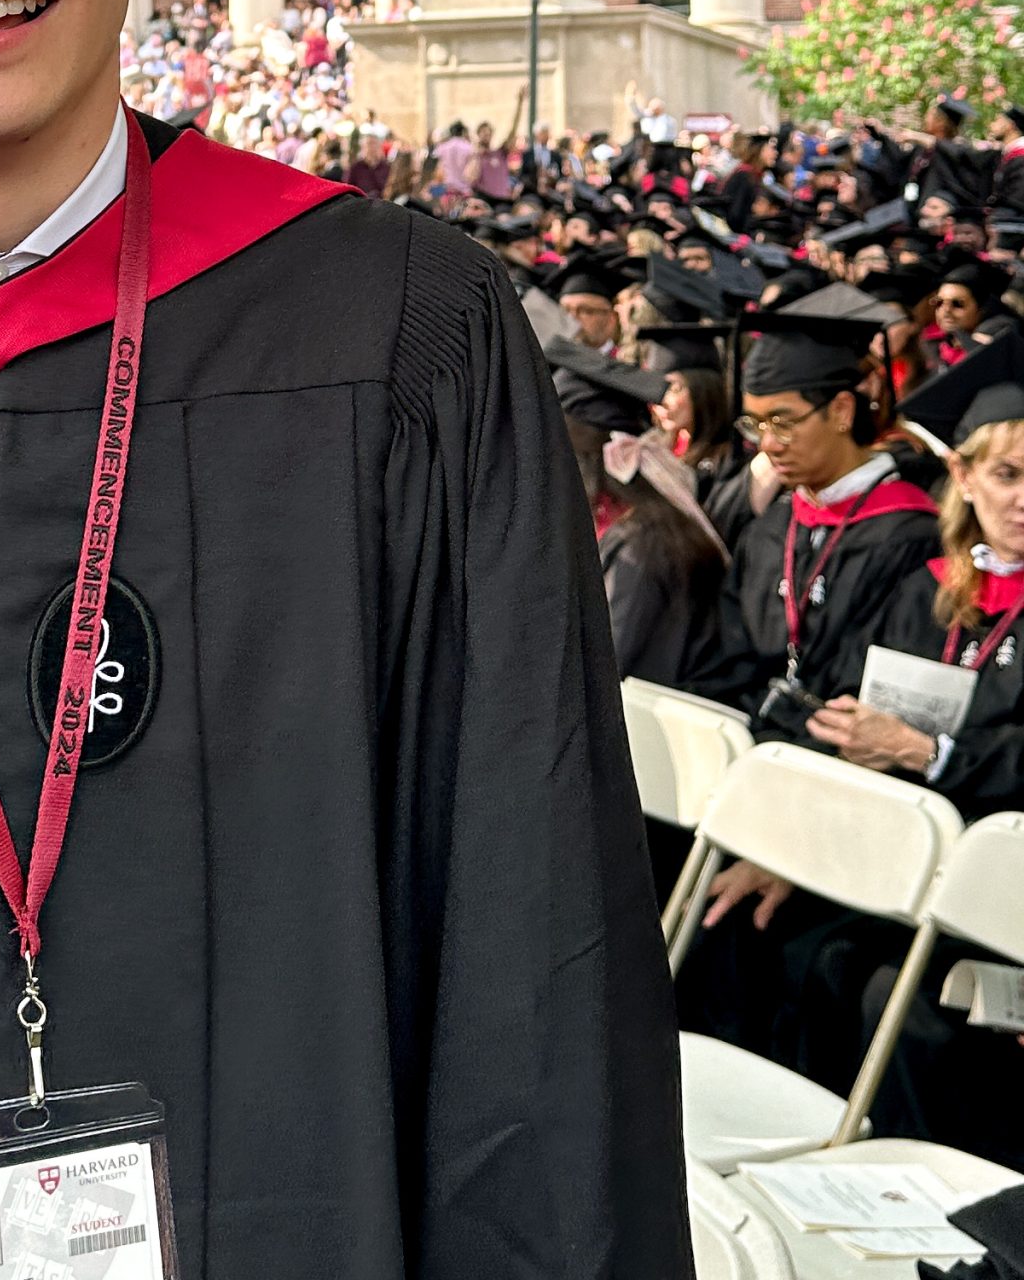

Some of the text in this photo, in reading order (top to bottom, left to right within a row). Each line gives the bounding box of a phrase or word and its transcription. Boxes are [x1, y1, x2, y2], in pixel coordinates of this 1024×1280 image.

[53, 336, 135, 778] COMMENCEMENT 2024
[66, 1153, 139, 1178] HARVARD
[79, 1171, 127, 1186] UNIVERSITY
[71, 1215, 123, 1234] STUDENT
